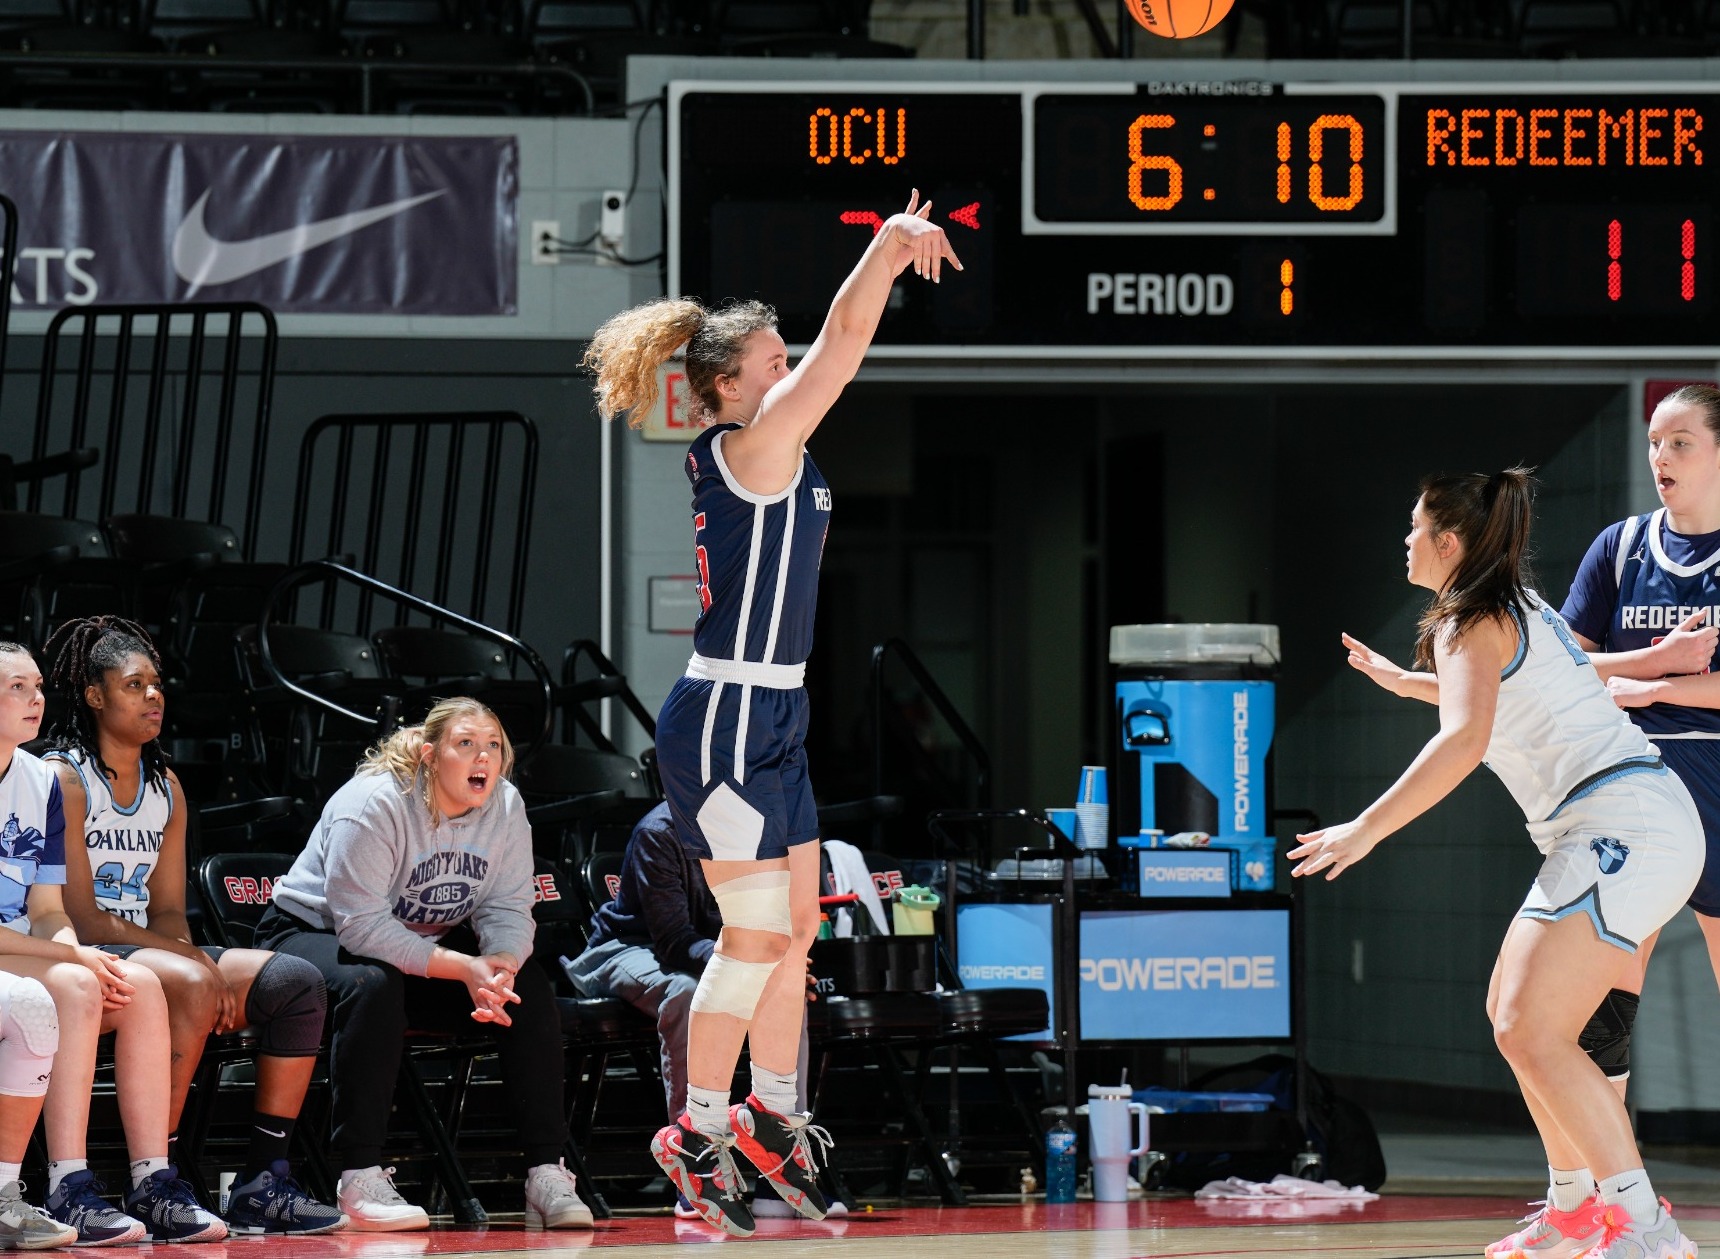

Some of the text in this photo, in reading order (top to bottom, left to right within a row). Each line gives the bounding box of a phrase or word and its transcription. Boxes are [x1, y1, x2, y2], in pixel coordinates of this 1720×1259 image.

[1139, 0, 1157, 25] on
[1148, 81, 1274, 96] DAKTRONICS
[810, 108, 906, 165] OCU
[1129, 115, 1363, 210] 6:10
[1427, 109, 1703, 166] REDEEMER
[1087, 259, 1293, 316] PERIOD 1
[1608, 219, 1695, 301] 11
[1233, 691, 1249, 831] POWERADE
[428, 885, 462, 902] 1885
[1144, 866, 1225, 882] POWERADE
